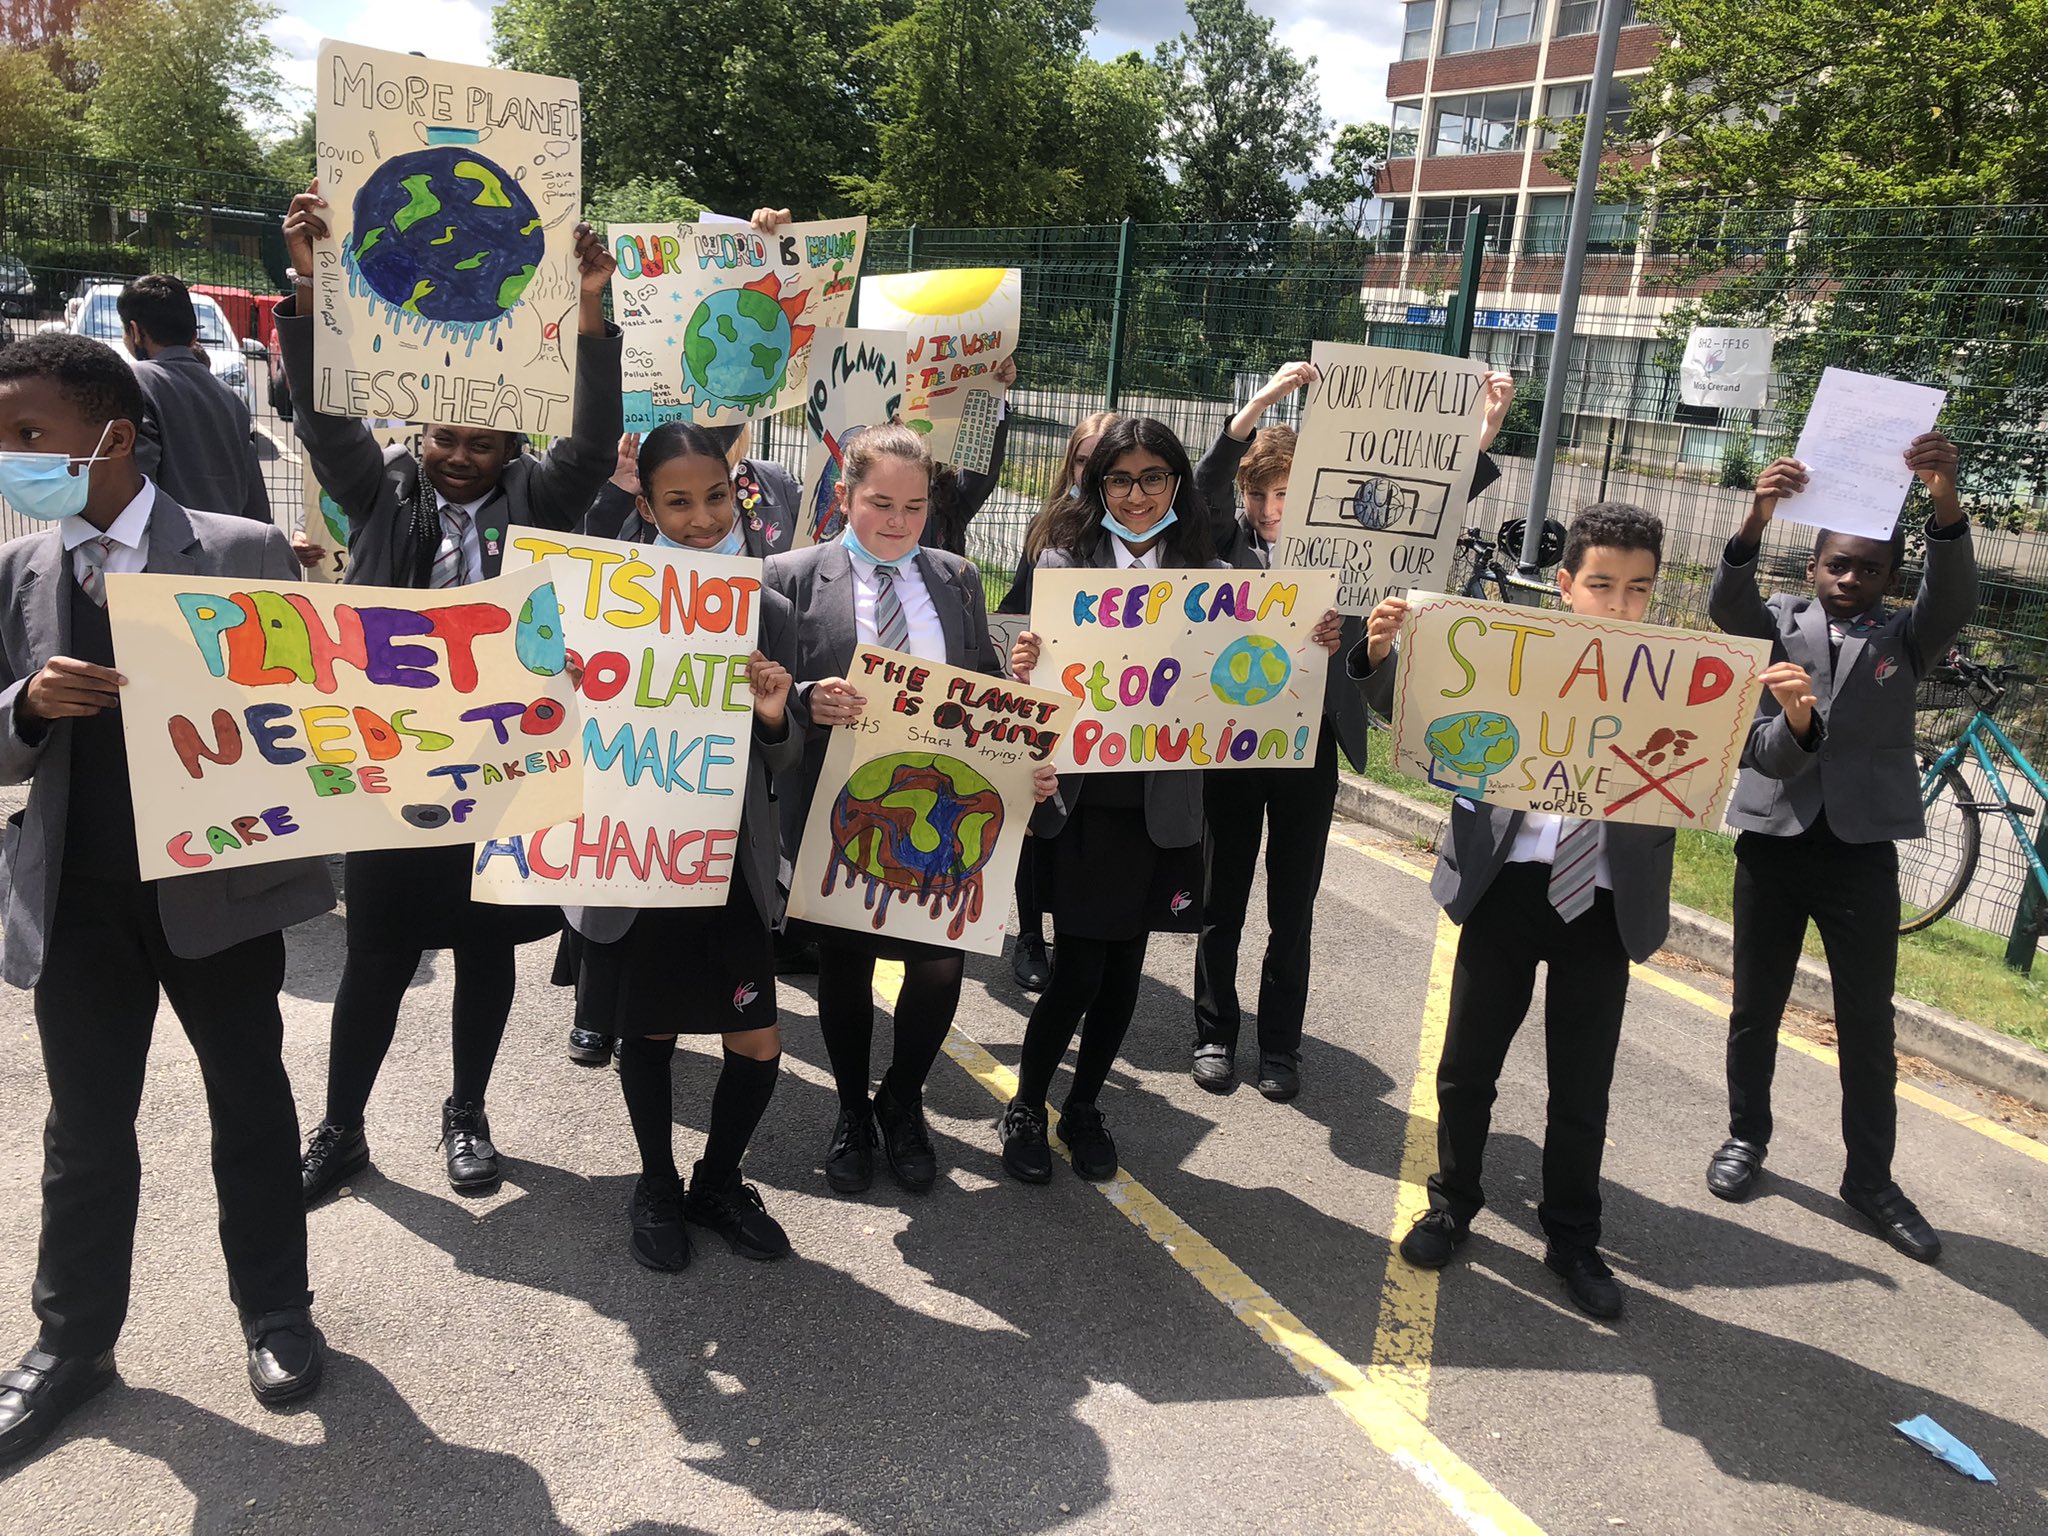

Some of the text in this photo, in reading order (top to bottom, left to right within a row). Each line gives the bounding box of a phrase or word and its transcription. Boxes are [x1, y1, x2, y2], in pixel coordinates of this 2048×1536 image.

[332, 55, 454, 121] MORE
[317, 141, 365, 165] COVID
[328, 166, 343, 185] 19
[541, 170, 575, 181] Save
[546, 180, 571, 190] our
[615, 234, 682, 280] OUR
[694, 233, 768, 270] WORLD
[1497, 312, 1541, 329] HOUSE
[1721, 338, 1750, 350] FF16
[623, 371, 663, 379] Pollution
[652, 390, 672, 398] level
[653, 382, 671, 390] Sea
[807, 379, 828, 443] NO
[831, 341, 897, 390] PLANET
[919, 367, 946, 389] THE
[1312, 361, 1488, 417] YOUR MENTALITY
[1707, 382, 1741, 393] Crerand
[319, 367, 570, 433] LESS HEAT
[625, 412, 682, 423] 2021 2018
[653, 397, 681, 405] rising
[1339, 428, 1470, 472] TO CHANGE
[1283, 536, 1435, 576] TRIGGERS OUR
[660, 563, 761, 636] NOT
[1072, 580, 1299, 629] KEEP CALM
[173, 590, 512, 695] PLANET
[1440, 615, 1736, 707] STAND
[635, 647, 752, 712] LATE
[861, 652, 1061, 725] THE PLANET
[168, 696, 567, 780] NEEDS TO
[907, 726, 953, 748] Start
[977, 745, 1024, 765] trying!
[1539, 709, 1623, 759] UP
[305, 748, 572, 798] BE TAKEN
[583, 717, 736, 796] MAKE
[1518, 755, 1613, 794] SAVE
[1551, 786, 1588, 803] THE
[165, 798, 478, 868] CARE OF
[475, 812, 738, 885] A CHANGE
